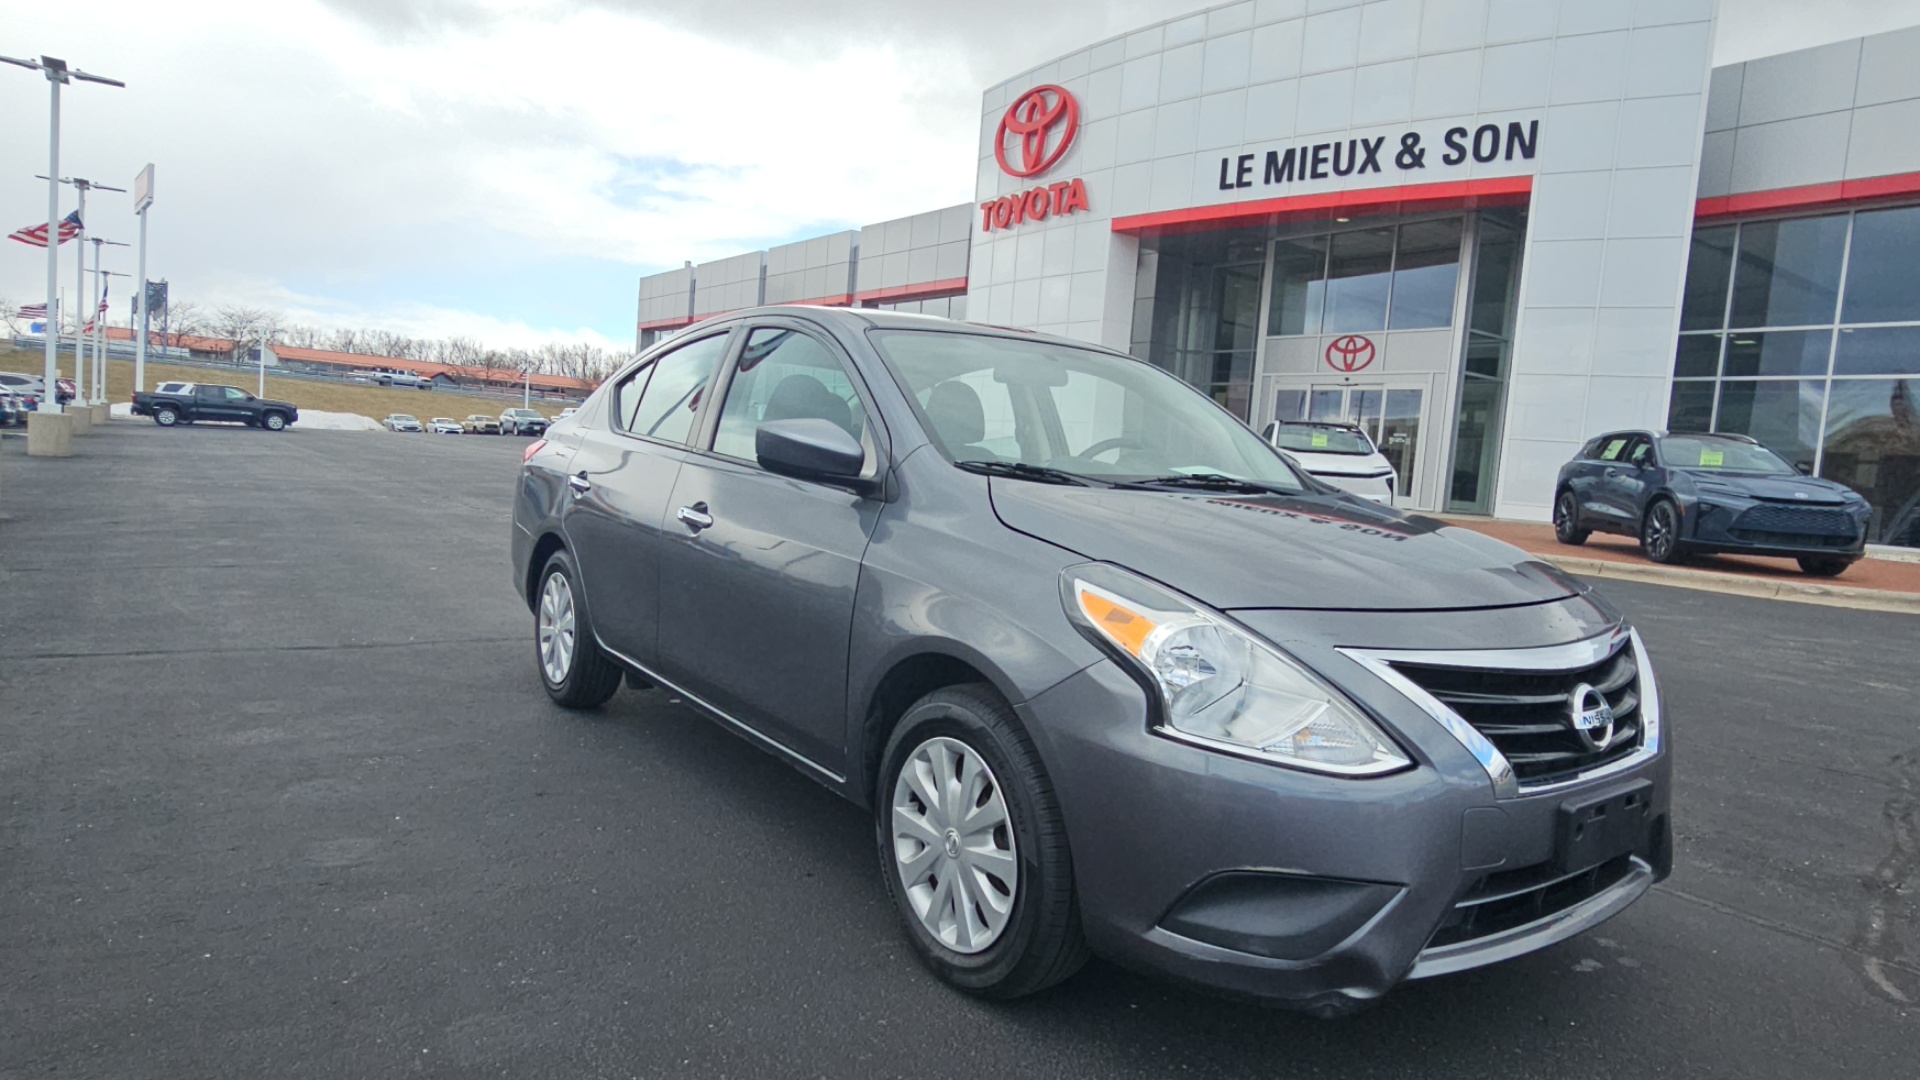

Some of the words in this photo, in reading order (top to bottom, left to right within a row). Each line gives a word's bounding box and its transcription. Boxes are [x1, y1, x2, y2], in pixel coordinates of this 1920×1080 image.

[1219, 154, 1255, 190] LE
[1264, 136, 1386, 185] MIEUX
[1395, 132, 1426, 170] &
[1442, 120, 1539, 166] SON
[980, 178, 1089, 232] TOYOTA
